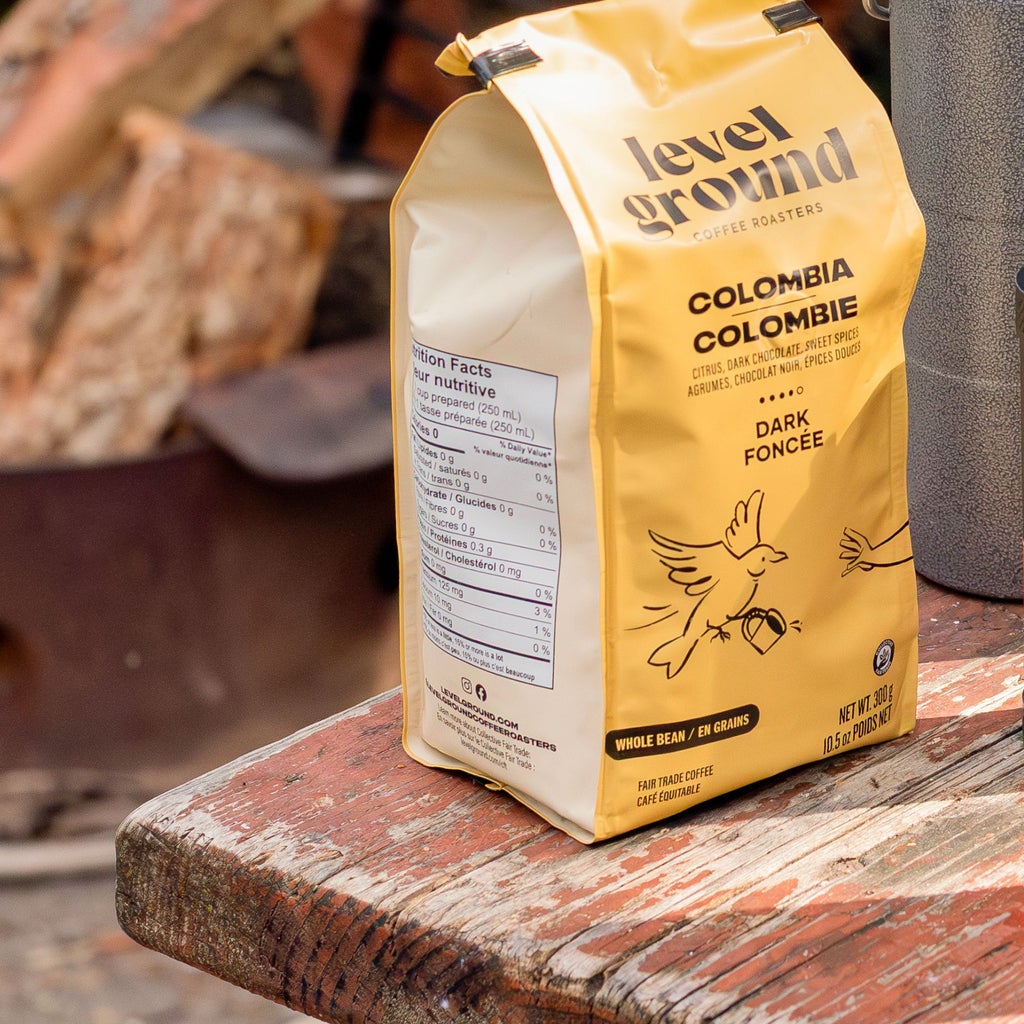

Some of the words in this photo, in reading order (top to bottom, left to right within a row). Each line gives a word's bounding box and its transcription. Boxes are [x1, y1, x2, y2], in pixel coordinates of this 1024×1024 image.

[623, 105, 793, 182] level
[623, 127, 859, 241] ground
[693, 220, 748, 242] COFFEE
[752, 202, 823, 228] ROASTERS
[688, 258, 855, 315] COLOMBIA
[693, 295, 858, 354] COLOMBIE
[412, 344, 446, 368] rition
[451, 357, 493, 378] Facts
[692, 362, 726, 380] CITRUS,
[727, 355, 750, 371] DARK
[752, 343, 804, 365] CHOCOLATE,
[805, 335, 832, 352] SWEET
[834, 326, 860, 345] SPICES
[688, 378, 733, 397] AGRUMES,
[734, 366, 777, 386] CHOCOLAT
[779, 359, 803, 376] NOIR,
[804, 351, 834, 368] ÉPICES
[835, 341, 861, 359] DOUCES
[414, 366, 430, 383] eur
[434, 375, 497, 399] nutritive
[431, 393, 475, 411] prepared
[478, 401, 500, 417] (250
[502, 408, 522, 424] mL)
[420, 402, 441, 418] tasse
[444, 410, 487, 429] préparée
[490, 420, 512, 435] (250
[515, 427, 535, 441] mL)
[756, 409, 810, 439] DARK
[432, 428, 439, 439] 0
[481, 448, 504, 458] valeur
[507, 442, 526, 454] Daily
[744, 428, 824, 466] FONCÉE
[440, 451, 446, 461] 0
[448, 455, 455, 465] g
[431, 473, 453, 486] trans
[455, 478, 462, 488] 0
[463, 482, 470, 492] g
[439, 465, 472, 479] saturés
[473, 471, 480, 480] 0
[481, 475, 488, 484] g
[535, 472, 542, 482] 0
[455, 494, 497, 511] Glucides
[499, 503, 506, 513] 0
[507, 508, 514, 517] g
[536, 492, 543, 502] 0
[450, 506, 456, 516] 0
[458, 510, 465, 520] g
[431, 514, 459, 531] Sucres
[461, 522, 468, 532] 0
[469, 526, 476, 536] g
[539, 524, 545, 534] 0
[430, 528, 468, 549] Protéines
[470, 541, 485, 553] 0.3
[486, 547, 493, 557] g
[539, 538, 546, 548] 0
[436, 562, 447, 576] mg
[445, 550, 497, 572] Cholestérol
[499, 563, 506, 573] 0
[507, 566, 522, 578] mg
[438, 578, 450, 592] 125
[451, 586, 464, 599] mg
[535, 588, 542, 598] 0
[441, 598, 452, 612] mg
[534, 606, 541, 616] 3
[442, 615, 453, 629] mg
[534, 625, 539, 635] 1
[495, 653, 504, 662] lot
[533, 643, 539, 653] 0
[505, 666, 536, 682] beaucoup
[440, 685, 519, 731] LEVELGROUND.COM
[839, 701, 857, 725] NET
[857, 694, 872, 716] WT.
[873, 684, 888, 709] 300
[888, 683, 894, 703] g
[615, 733, 655, 751] WHOLE
[656, 729, 686, 746] BEAN
[697, 724, 711, 738] EN
[713, 713, 750, 734] GRAINS
[823, 732, 841, 755] 10.5
[852, 714, 878, 741] POIDS
[878, 703, 893, 728] NET
[502, 739, 513, 751] Fair
[505, 751, 515, 763] Fair
[637, 776, 657, 792] FAIR
[657, 772, 684, 788] TRADE
[685, 764, 714, 782] COFFEE
[636, 791, 657, 807] CAFÉ
[659, 782, 701, 803] ÉQUITABLE
